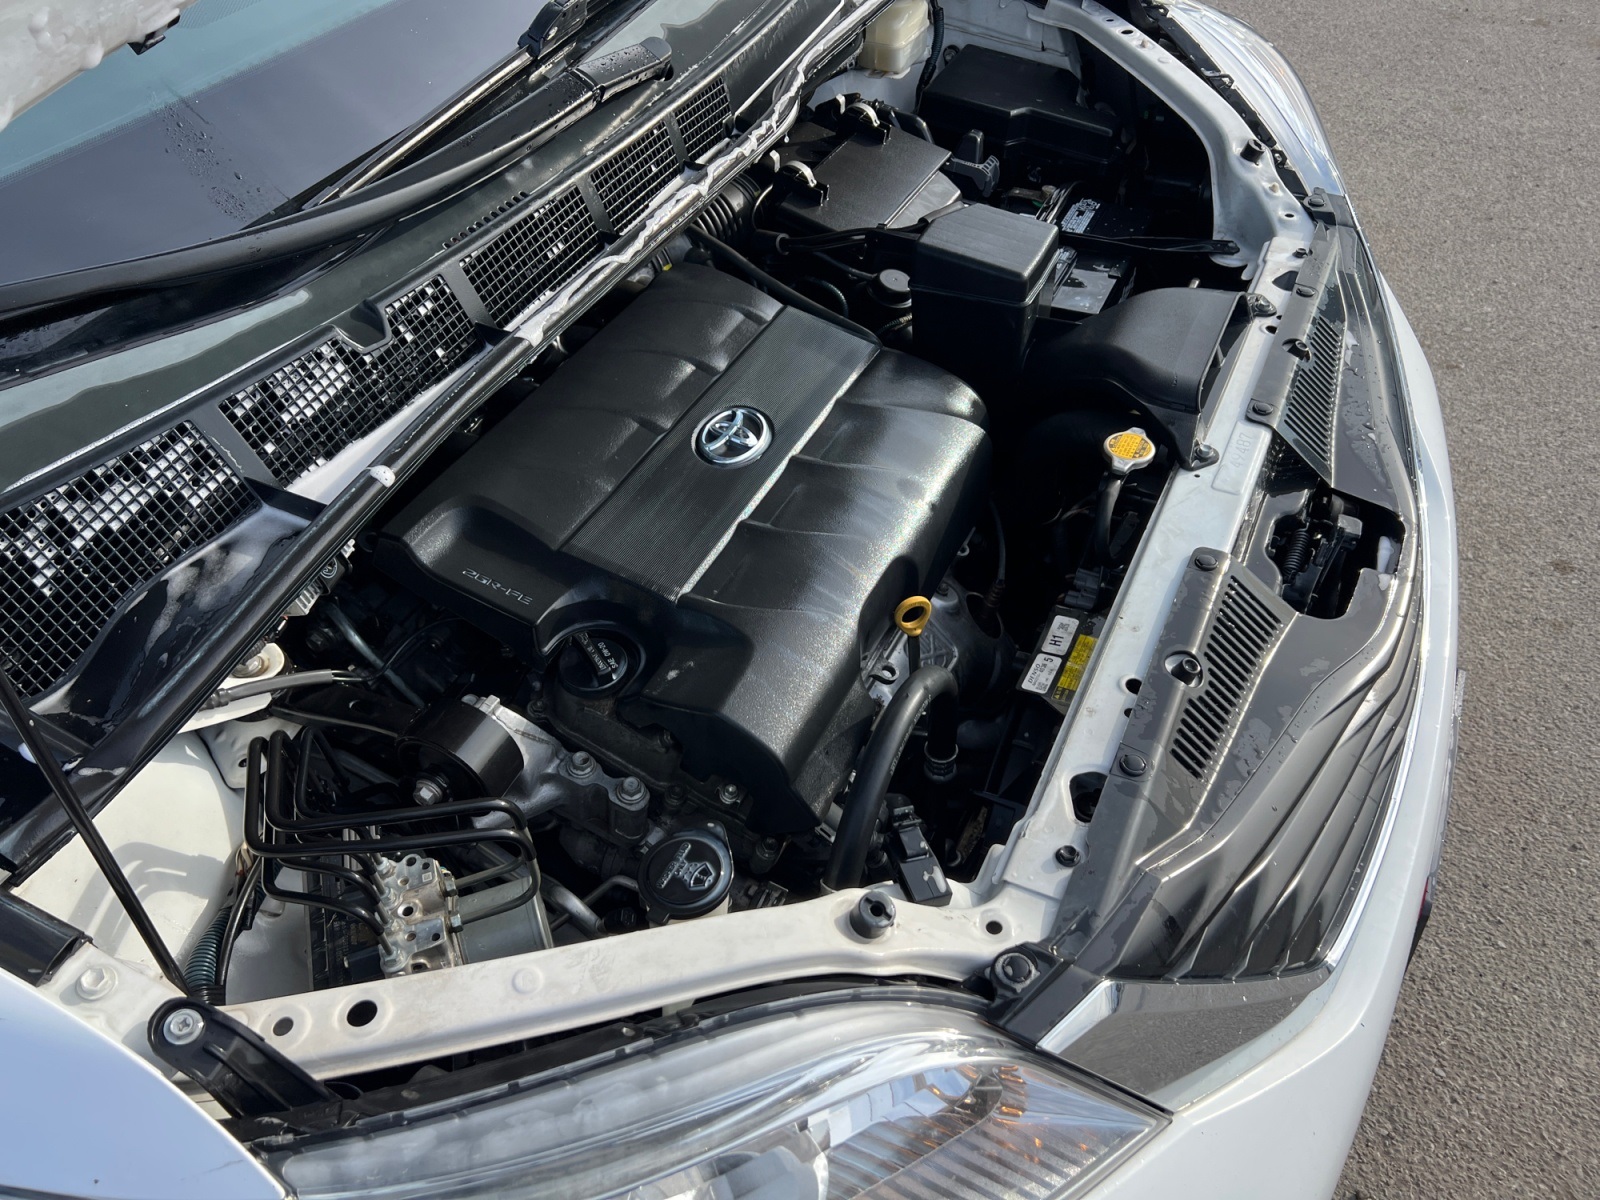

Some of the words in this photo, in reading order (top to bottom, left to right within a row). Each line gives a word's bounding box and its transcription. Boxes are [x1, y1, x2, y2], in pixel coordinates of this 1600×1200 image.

[462, 568, 533, 605] 2GR-FE
[1049, 634, 1064, 646] H1
[607, 656, 618, 669] SAE
[1028, 664, 1040, 683] DENSO
